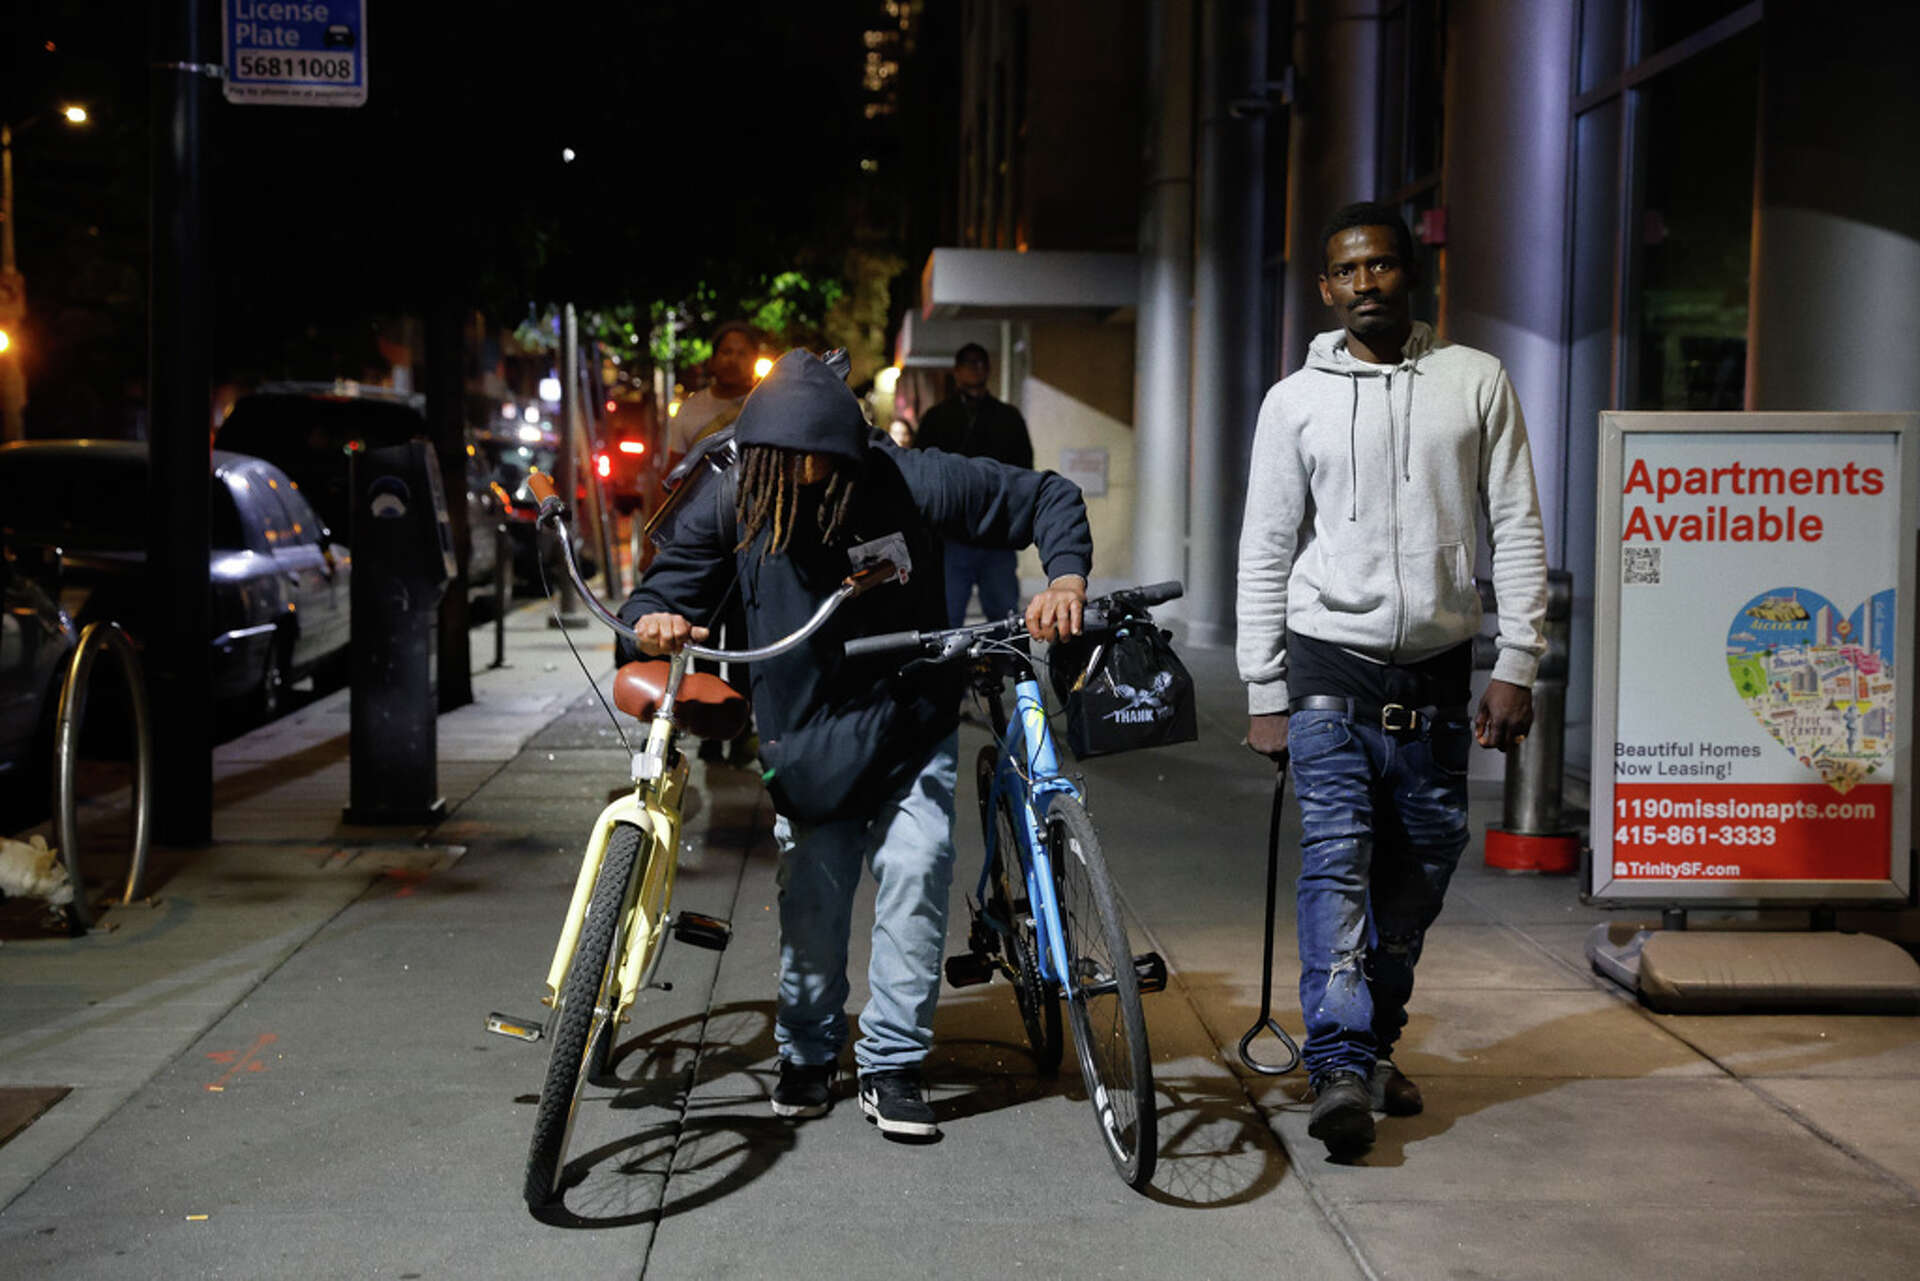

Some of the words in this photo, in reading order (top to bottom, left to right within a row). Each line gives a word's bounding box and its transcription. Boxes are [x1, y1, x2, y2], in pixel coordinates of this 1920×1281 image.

[236, 0, 329, 22] License
[236, 23, 299, 46] Plate
[240, 56, 351, 78] 56811008
[1623, 458, 1884, 503] Apartments
[1622, 506, 1824, 542] Available
[1114, 709, 1154, 723] THANK
[1614, 742, 1694, 757] Beautiful
[1699, 742, 1761, 757] Homes
[1614, 761, 1652, 776] Now
[1657, 761, 1733, 780] Leasing!
[1616, 799, 1876, 823] 1190missionapts.com
[1615, 826, 1777, 846] 415-861-3333
[1629, 861, 1740, 879] TrinitySF.com
